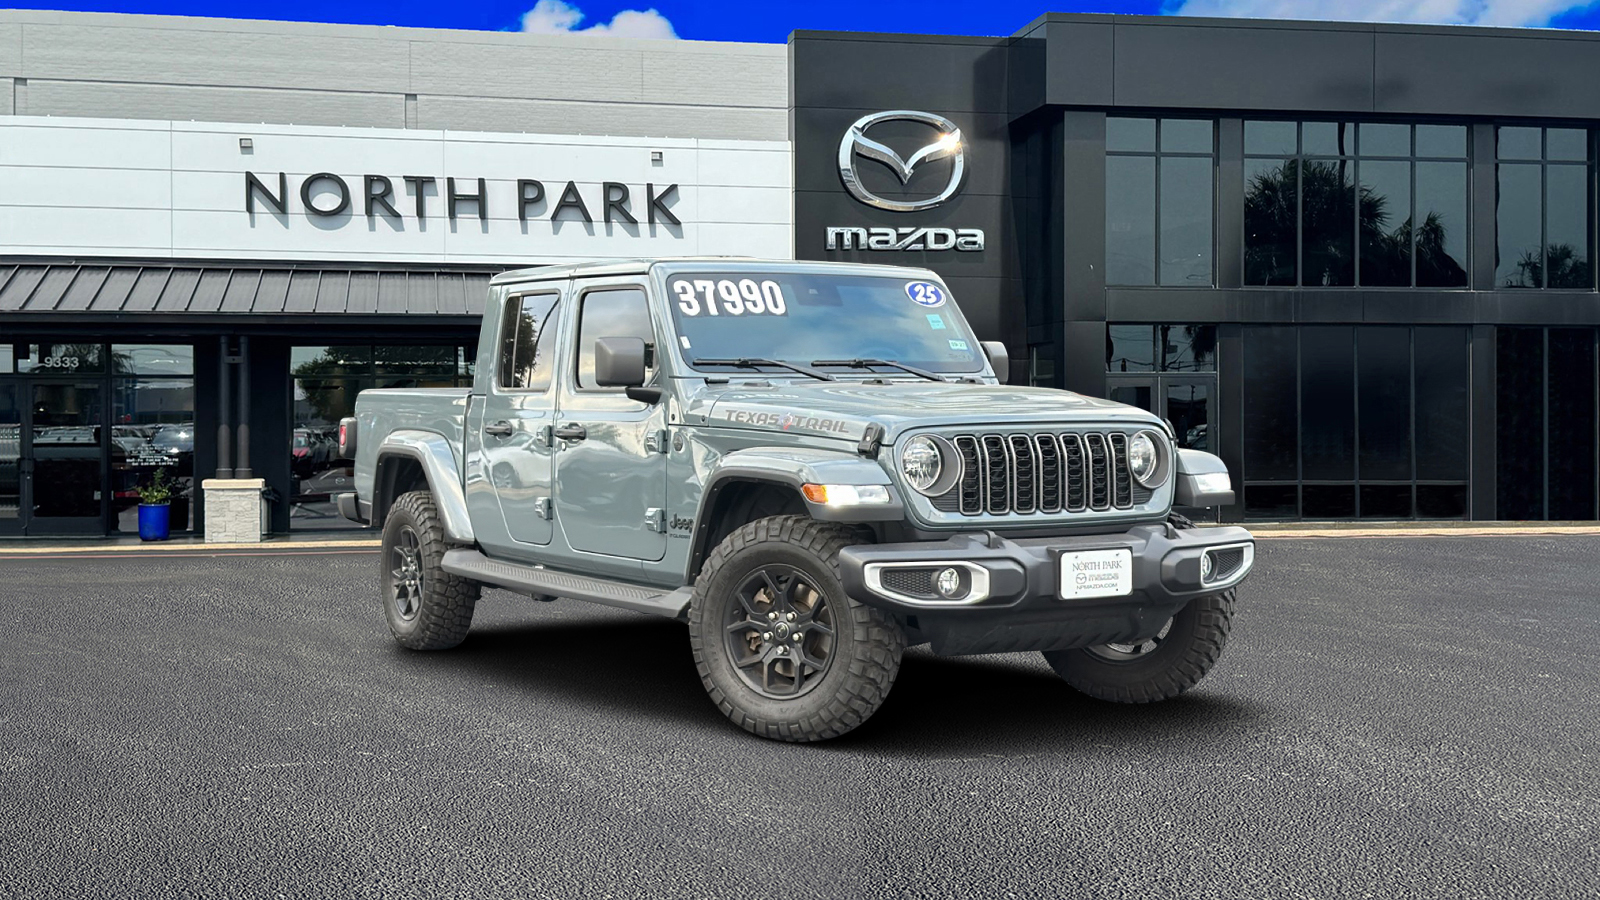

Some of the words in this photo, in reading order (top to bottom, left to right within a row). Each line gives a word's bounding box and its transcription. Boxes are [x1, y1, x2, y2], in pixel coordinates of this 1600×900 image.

[245, 171, 485, 219] NORTH
[517, 178, 682, 225] PARK
[673, 279, 787, 316] 37990
[913, 284, 937, 304] 25
[44, 356, 79, 368] 9333
[725, 409, 780, 426] TEXAS
[794, 415, 849, 434] TRAIL
[670, 513, 694, 533] Jeep
[1072, 561, 1100, 571] NORTH
[1102, 560, 1122, 569] PARK
